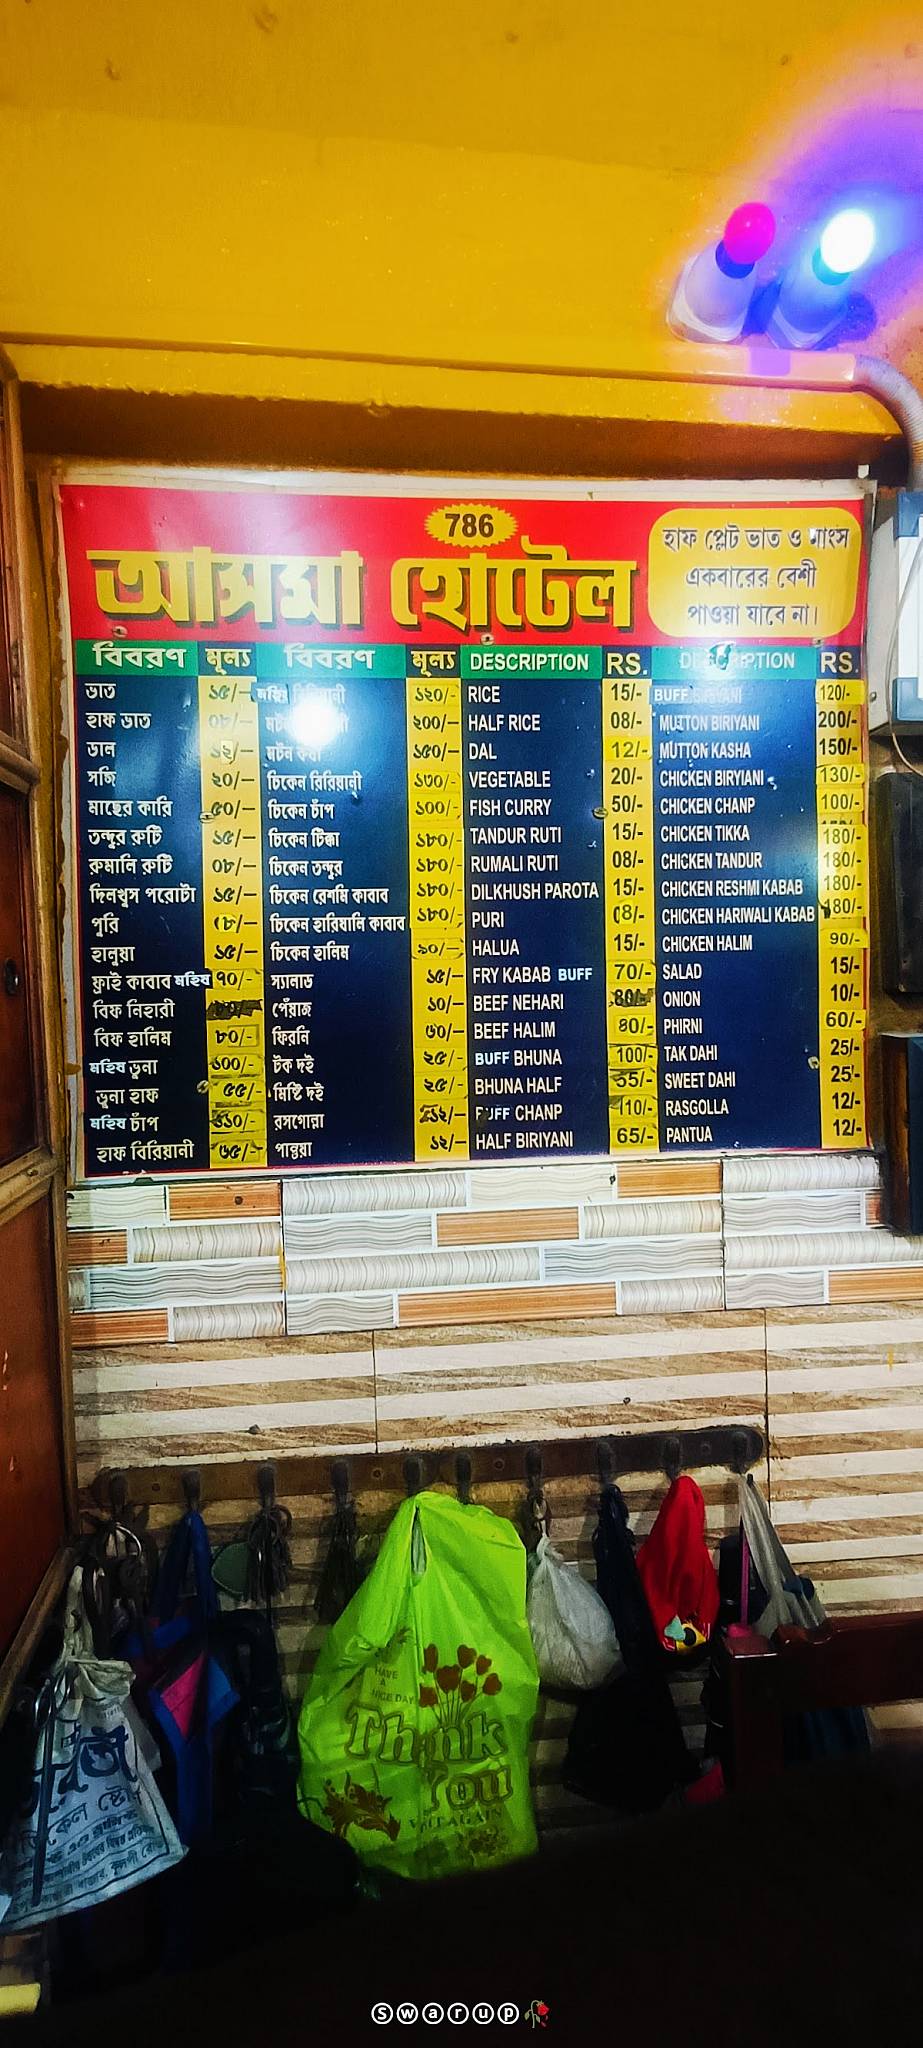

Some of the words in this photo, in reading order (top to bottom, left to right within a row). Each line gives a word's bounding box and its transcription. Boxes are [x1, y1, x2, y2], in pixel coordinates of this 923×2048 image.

[445, 512, 493, 539] 786
[663, 525, 696, 549] হাফ
[705, 522, 739, 552] প্লেট
[748, 525, 778, 549] ভাত
[790, 526, 801, 548] ও
[686, 567, 768, 590] একবারের
[778, 557, 817, 590] বেশী
[87, 547, 365, 629] আসমা
[391, 535, 638, 635] হোটেল
[748, 602, 784, 626] যাবে
[92, 641, 187, 669] বিবরণ
[205, 648, 251, 675] মূল্য
[284, 643, 375, 670] বিবরণ
[410, 651, 456, 677] মূল্য
[470, 653, 589, 671] DESCRIPTION
[607, 652, 648, 676] RS.
[820, 651, 859, 674] RS.
[85, 683, 116, 699] ভাত
[468, 686, 500, 703] RICE
[611, 683, 642, 702] 15/-
[654, 689, 688, 702] BUFF
[820, 685, 850, 701] 120/-
[86, 713, 116, 729] হাফ
[120, 713, 151, 729] ভাত
[468, 715, 504, 732] HALF
[509, 714, 541, 731] RICE
[610, 712, 642, 731] 08/-
[659, 715, 708, 731] MUTTON
[712, 715, 759, 731] BIRIYANI
[818, 711, 857, 729] 200/-
[469, 743, 497, 760] DAL
[611, 741, 648, 759] 12/-
[659, 741, 708, 759] MUTTON
[712, 742, 751, 759] KASHA
[819, 738, 857, 756] 150/-
[469, 771, 551, 788] VEGETABLE
[611, 767, 643, 785] 20/-
[660, 770, 711, 787] CHICKEN
[715, 769, 764, 786] BIRYIANI
[820, 766, 860, 783] 130/-
[88, 800, 133, 817] মাছের
[137, 795, 173, 817] কারি
[268, 799, 307, 820] চিকেন
[470, 799, 501, 816] FISH
[504, 799, 552, 816] CURRY
[612, 795, 643, 813] 50/-
[660, 798, 712, 814] CHICKEN
[715, 797, 755, 814] CHANP
[821, 793, 860, 810] 100/-
[268, 827, 308, 848] চিকেন
[470, 827, 527, 845] TANDUR
[530, 826, 562, 844] RUTI
[612, 822, 644, 841] 15/-
[660, 825, 712, 842] CHICKEN
[715, 825, 750, 842] TIKKA
[823, 828, 861, 844] 180/-
[268, 856, 308, 876] চিকেন
[471, 855, 523, 873] RUMALI
[527, 855, 559, 872] RUTI
[612, 850, 644, 869] 08/-
[661, 853, 712, 870] CHICKEN
[715, 852, 762, 869] TANDUR
[823, 852, 861, 868] 180/-
[472, 883, 541, 901] DILKHUSH
[544, 882, 599, 900] PAROTA
[613, 878, 644, 896] 15/-
[661, 881, 712, 898] CHICKEN
[716, 880, 760, 896] RESHMI
[763, 879, 803, 895] KABAB
[823, 875, 861, 891] 180/-
[145, 882, 196, 905] পরোটা
[269, 884, 309, 905] চিকেন
[352, 888, 389, 904] কাবাব
[269, 913, 309, 933] চিকেন
[369, 916, 406, 931] কাবাব
[472, 911, 505, 929] PURI
[662, 909, 713, 925] CHICKEN
[716, 907, 771, 924] HARIWALI
[775, 906, 815, 922] KABAB
[472, 939, 519, 957] HALUA
[614, 933, 645, 952] 15/-
[662, 936, 713, 953] CHICKEN
[717, 935, 752, 952] HALIM
[830, 932, 860, 946] 90/-
[270, 941, 310, 962] চিকেন
[614, 964, 651, 980] 70/-
[663, 963, 702, 980] SALAD
[830, 956, 860, 974] 15/-
[126, 975, 171, 990] কাবাব
[473, 967, 500, 984] FRY
[503, 966, 551, 983] KABAB
[558, 967, 593, 982] BUFF
[663, 991, 701, 1008] ONION
[830, 984, 860, 1002] 10/-
[92, 999, 122, 1019] বিফ
[127, 998, 175, 1019] নিহারী
[473, 995, 509, 1012] BEEF
[513, 993, 564, 1010] NEHARI
[618, 1017, 654, 1034] 80/-
[664, 1018, 702, 1034] PHIRNI
[826, 1012, 862, 1028] 60/-
[94, 1027, 123, 1048] বিফ
[474, 1022, 509, 1040] BEEF
[513, 1022, 556, 1039] HALIM
[617, 1046, 653, 1063] 100/-
[664, 1045, 687, 1062] TAK
[690, 1045, 718, 1061] DAHI
[830, 1039, 860, 1056] 25/-
[272, 1054, 293, 1074] টক
[295, 1053, 315, 1074] দই
[475, 1051, 510, 1066] BUFF
[513, 1049, 562, 1066] BHUNA
[475, 1077, 524, 1095] BHUNA
[527, 1076, 562, 1094] HALF
[664, 1073, 706, 1090] SWEET
[708, 1072, 736, 1088] DAHI
[129, 1088, 159, 1104] হাফ
[306, 1081, 324, 1102] দই
[665, 1098, 729, 1117] RASGOLLA
[832, 1092, 861, 1110] 12/-
[515, 1104, 563, 1121] CHANP
[617, 1127, 653, 1144] 65/-
[666, 1126, 712, 1143] PANTUA
[833, 1119, 862, 1136] 12/-
[476, 1133, 511, 1150] HALF
[515, 1131, 573, 1149] BIRIYANI
[97, 1147, 126, 1163] হাফ
[130, 1139, 194, 1161] বিরিয়ানী
